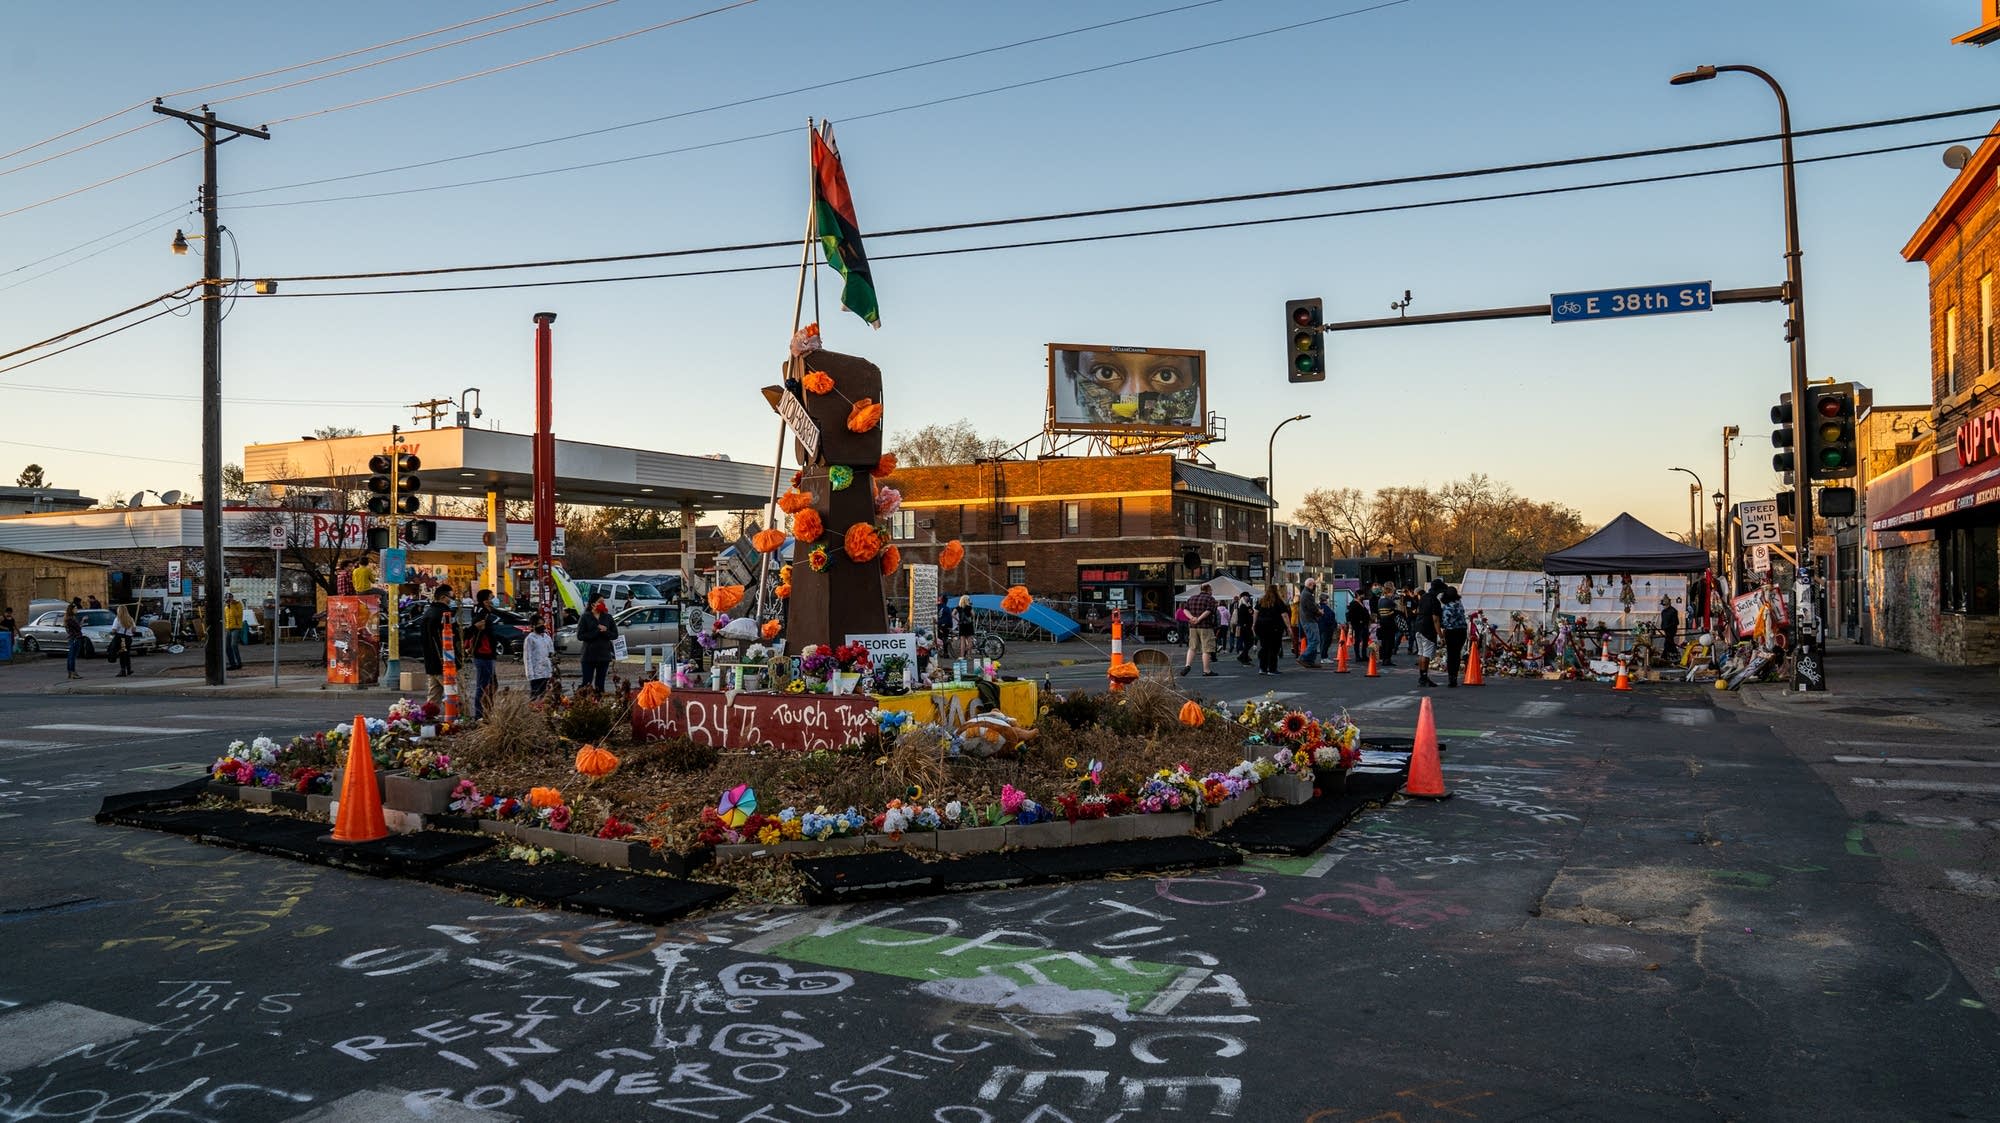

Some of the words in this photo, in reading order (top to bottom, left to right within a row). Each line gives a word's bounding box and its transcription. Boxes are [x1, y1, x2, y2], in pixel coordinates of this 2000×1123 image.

[1586, 297, 1601, 314] E
[1611, 292, 1669, 312] 38th
[1679, 288, 1706, 307] St
[1956, 417, 1982, 467] CUP
[1743, 504, 1776, 514] SPEED
[1747, 513, 1773, 523] LIMIT
[1745, 522, 1777, 541] 25
[156, 980, 303, 1014] This
[331, 1011, 562, 1062] REST
[437, 1036, 562, 1071] IN
[401, 1061, 714, 1118] POWER
